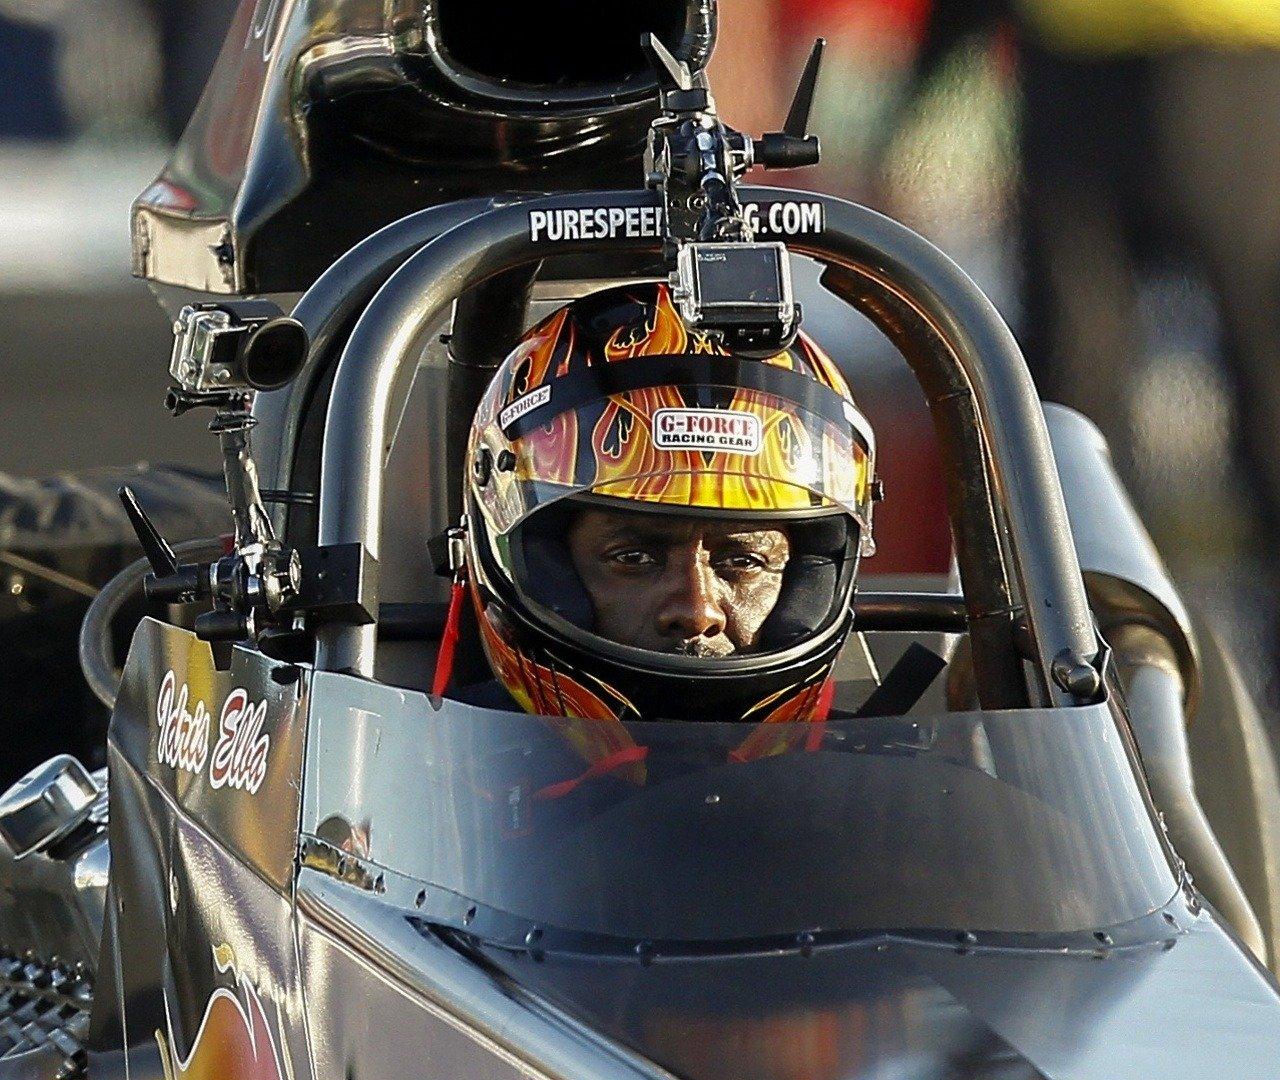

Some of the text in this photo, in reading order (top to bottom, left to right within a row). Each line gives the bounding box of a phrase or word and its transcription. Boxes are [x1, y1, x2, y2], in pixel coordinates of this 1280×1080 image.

[531, 202, 821, 242] PURESPEEG.COM
[661, 415, 753, 437] G-FORCE
[662, 433, 752, 446] RACING GEAR
[210, 688, 269, 795] Elba
